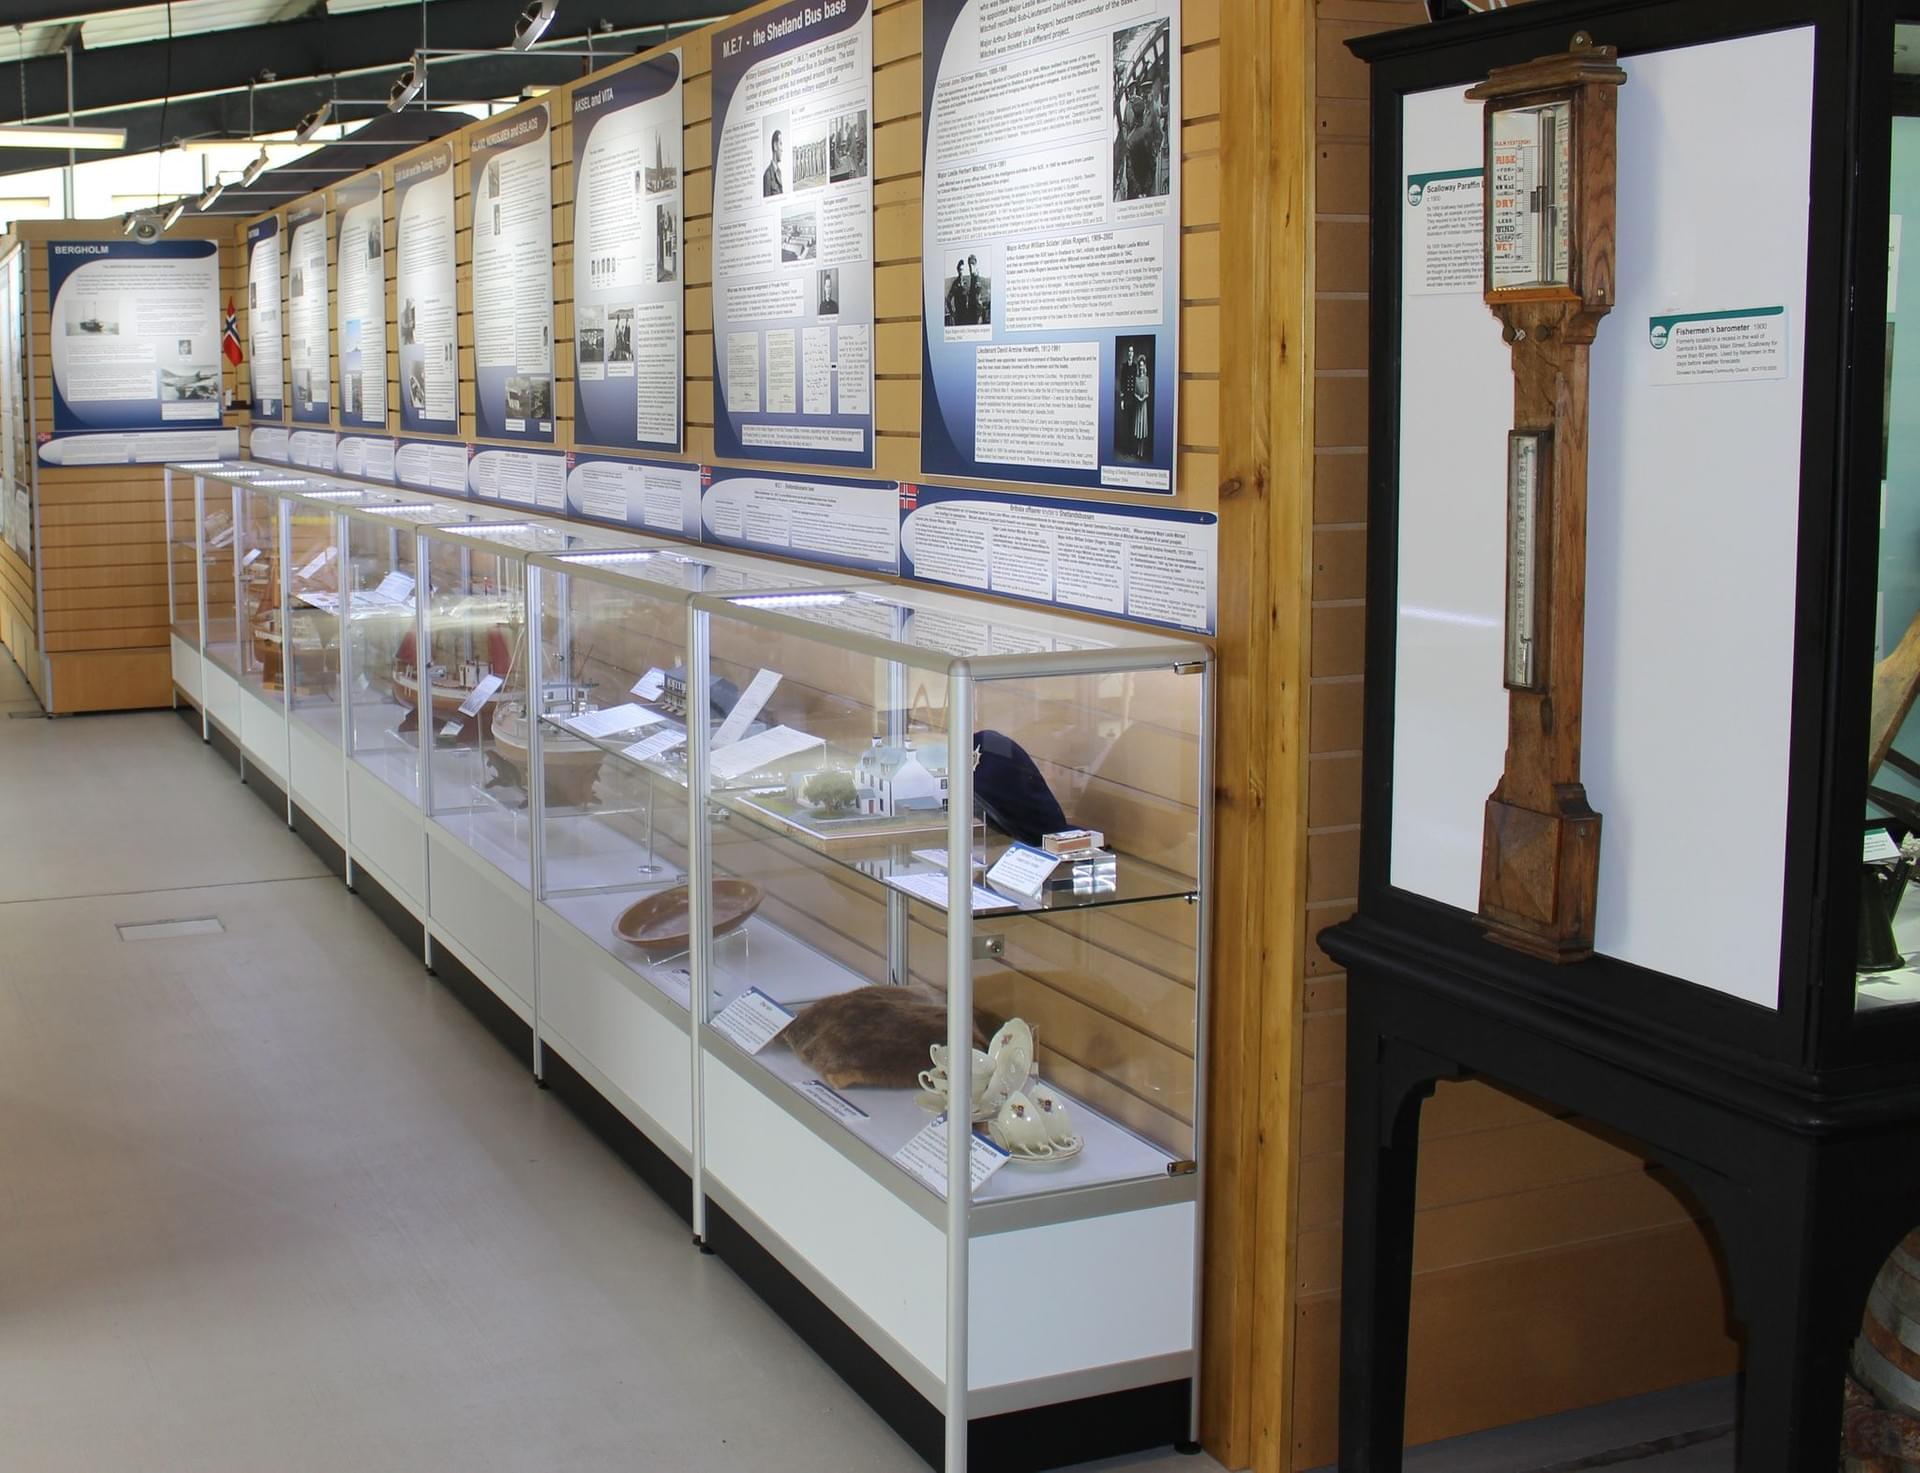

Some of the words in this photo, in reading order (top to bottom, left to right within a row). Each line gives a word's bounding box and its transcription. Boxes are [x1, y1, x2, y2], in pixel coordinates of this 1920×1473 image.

[723, 36, 743, 58] M.E.7
[753, 30, 765, 47] the
[767, 11, 802, 41] Shetland
[804, 8, 822, 26] Bus
[824, 0, 846, 18] base
[575, 96, 591, 112] AKSEL
[1427, 184, 1456, 194] Scalloway
[1457, 181, 1480, 190] Paraffin
[1496, 200, 1514, 208] DRY
[55, 246, 109, 254] BERGHOLM
[1676, 326, 1714, 335] Fishermen's
[1716, 324, 1750, 333] barometer
